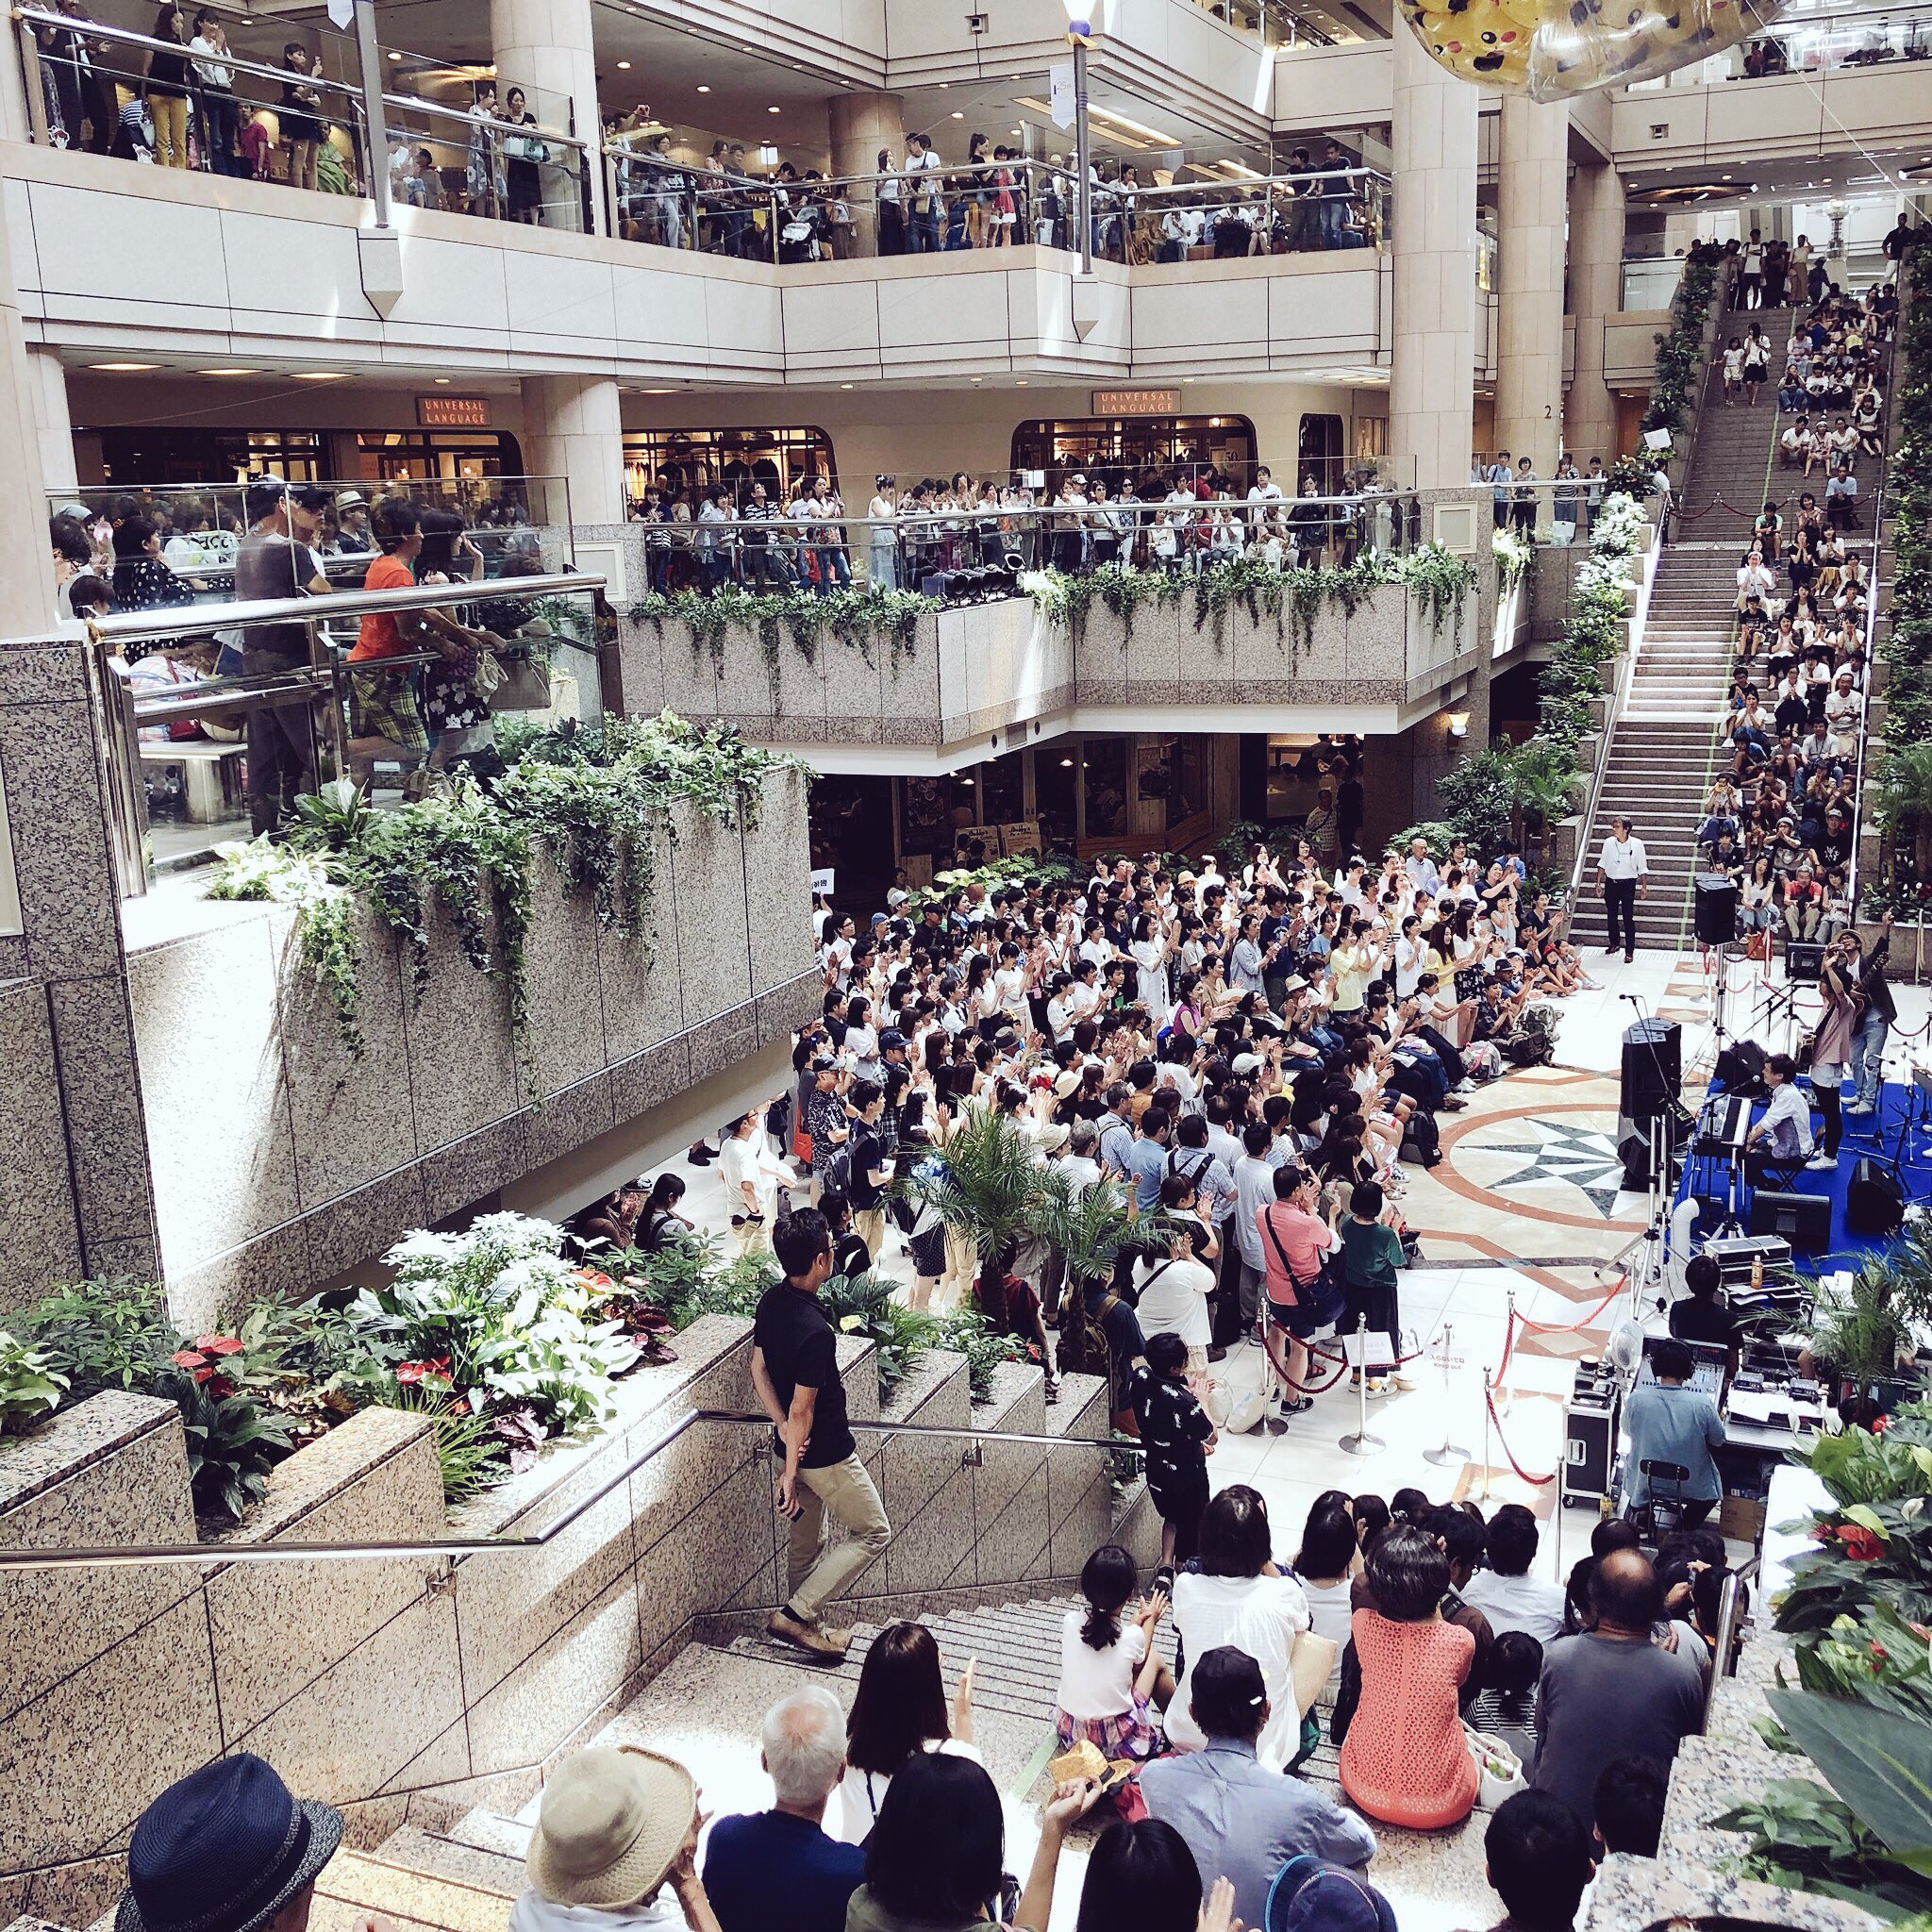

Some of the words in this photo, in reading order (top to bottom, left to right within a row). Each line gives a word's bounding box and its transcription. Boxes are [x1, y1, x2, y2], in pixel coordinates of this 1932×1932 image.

[1101, 391, 1173, 402] UNIVERSAL
[425, 400, 484, 411] UNIVERSAL
[1102, 403, 1173, 413] LANGUAGE
[1544, 405, 1552, 419] 2
[426, 413, 485, 424] LANGUAGE
